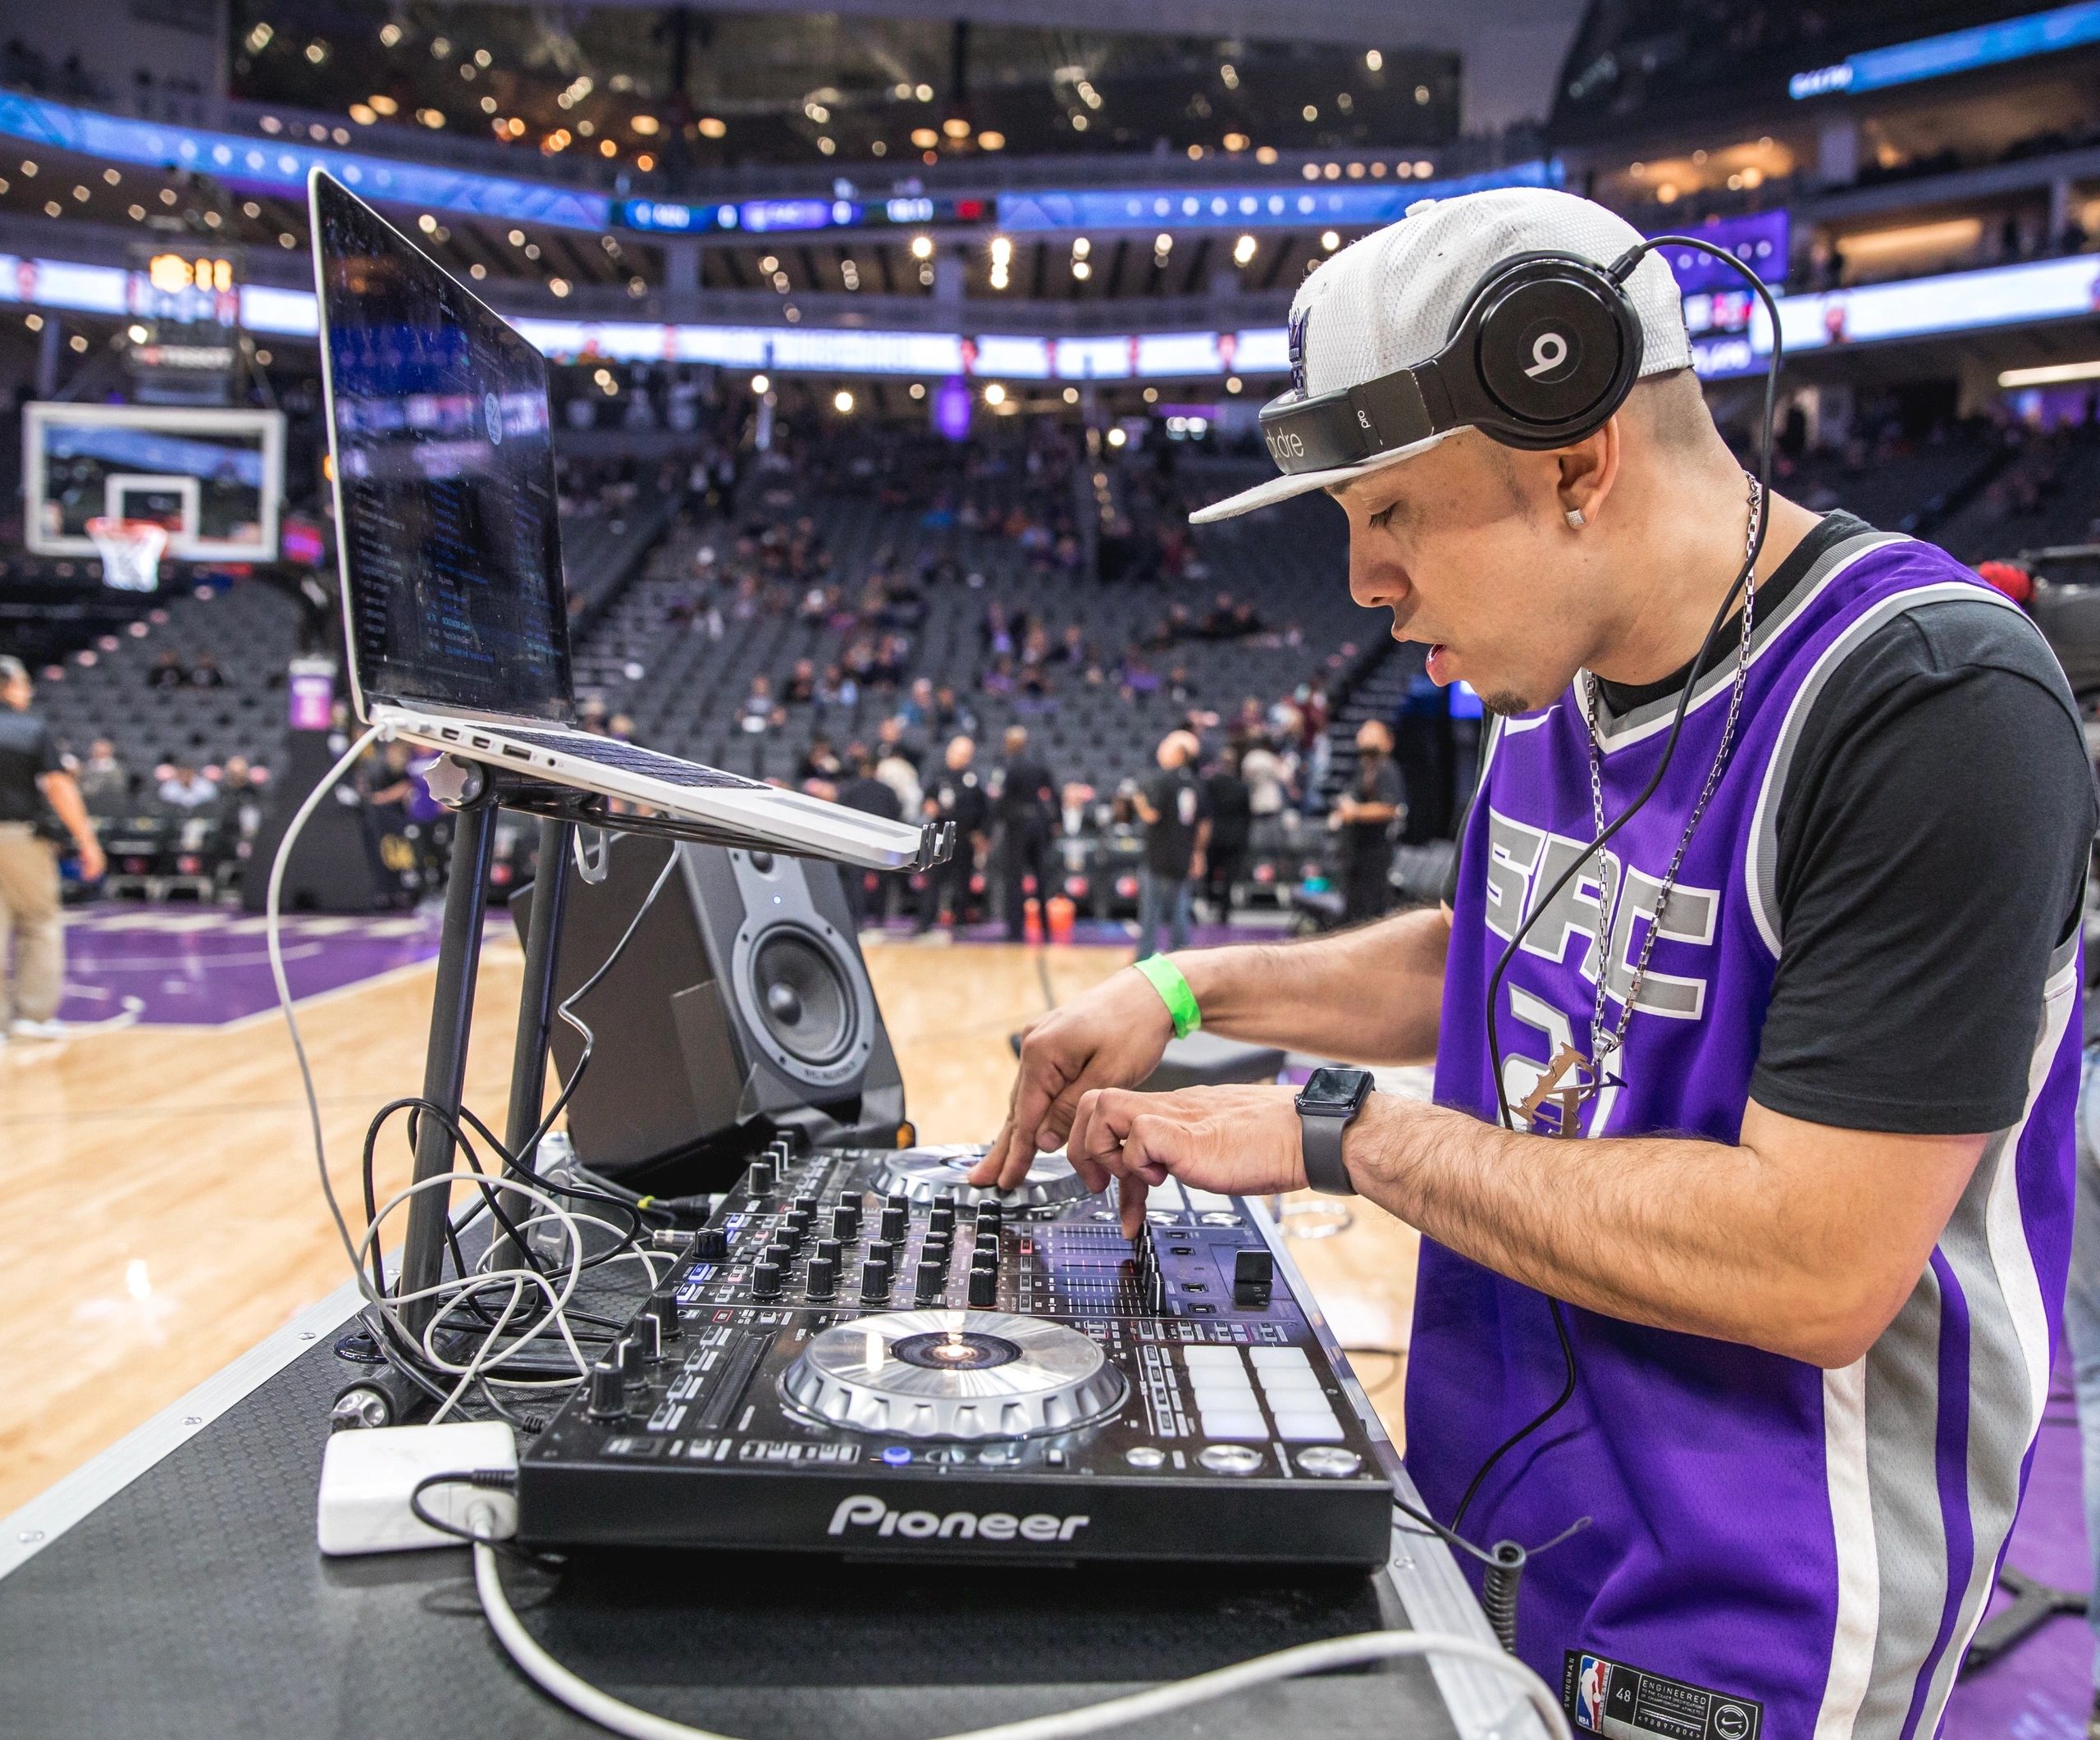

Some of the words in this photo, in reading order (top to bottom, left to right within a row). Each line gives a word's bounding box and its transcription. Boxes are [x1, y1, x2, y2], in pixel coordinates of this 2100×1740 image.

[1357, 410, 1372, 428] pro
[1485, 806, 1720, 1020] SAC
[827, 1494, 1089, 1541] Pioneer
[1564, 1657, 1575, 1708] SWINGMAN
[1615, 1687, 1632, 1702] 48
[1642, 1679, 1706, 1705] ENGINEERED
[1578, 1715, 1590, 1727] NBA
